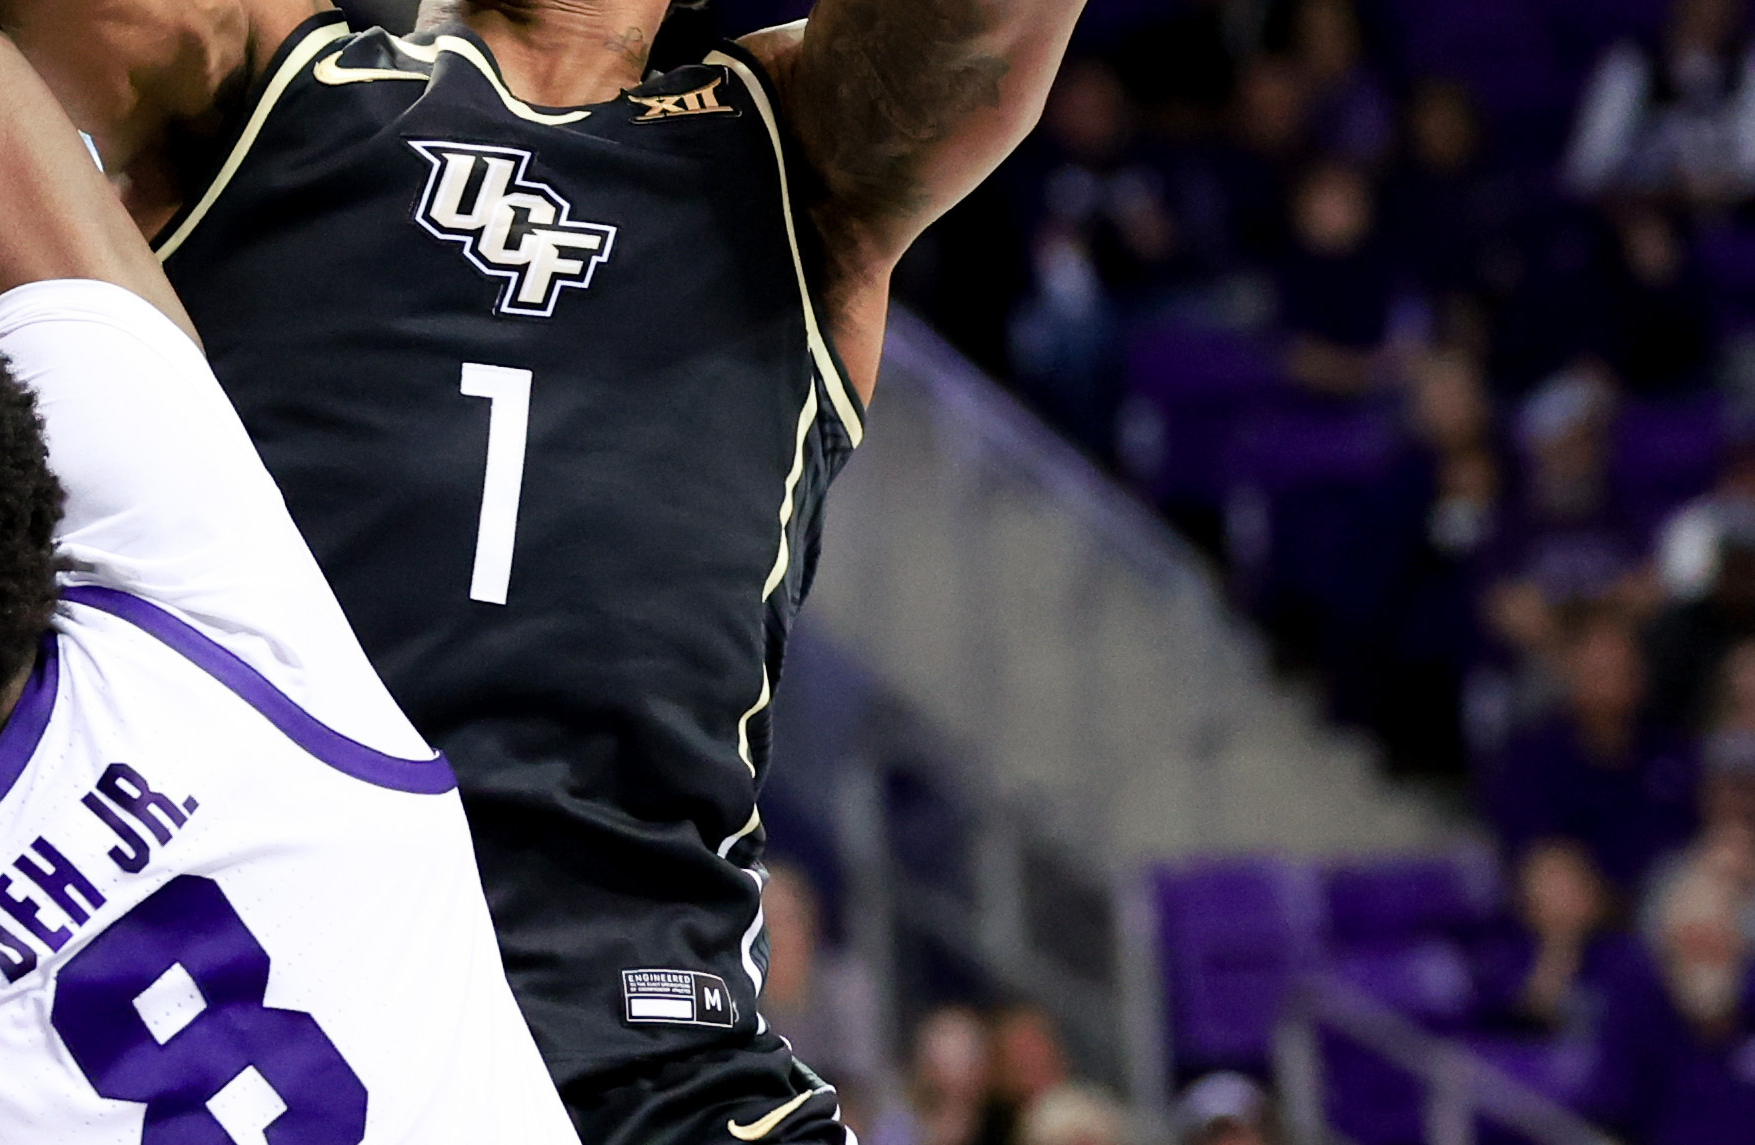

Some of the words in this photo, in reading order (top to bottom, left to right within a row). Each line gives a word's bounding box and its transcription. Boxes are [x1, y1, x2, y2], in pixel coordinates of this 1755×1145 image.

[628, 77, 733, 120] XII
[408, 140, 617, 316] UCF
[460, 362, 533, 606] 1
[80, 763, 200, 874] JR.
[51, 874, 369, 1145] 8
[703, 986, 722, 1012] M
